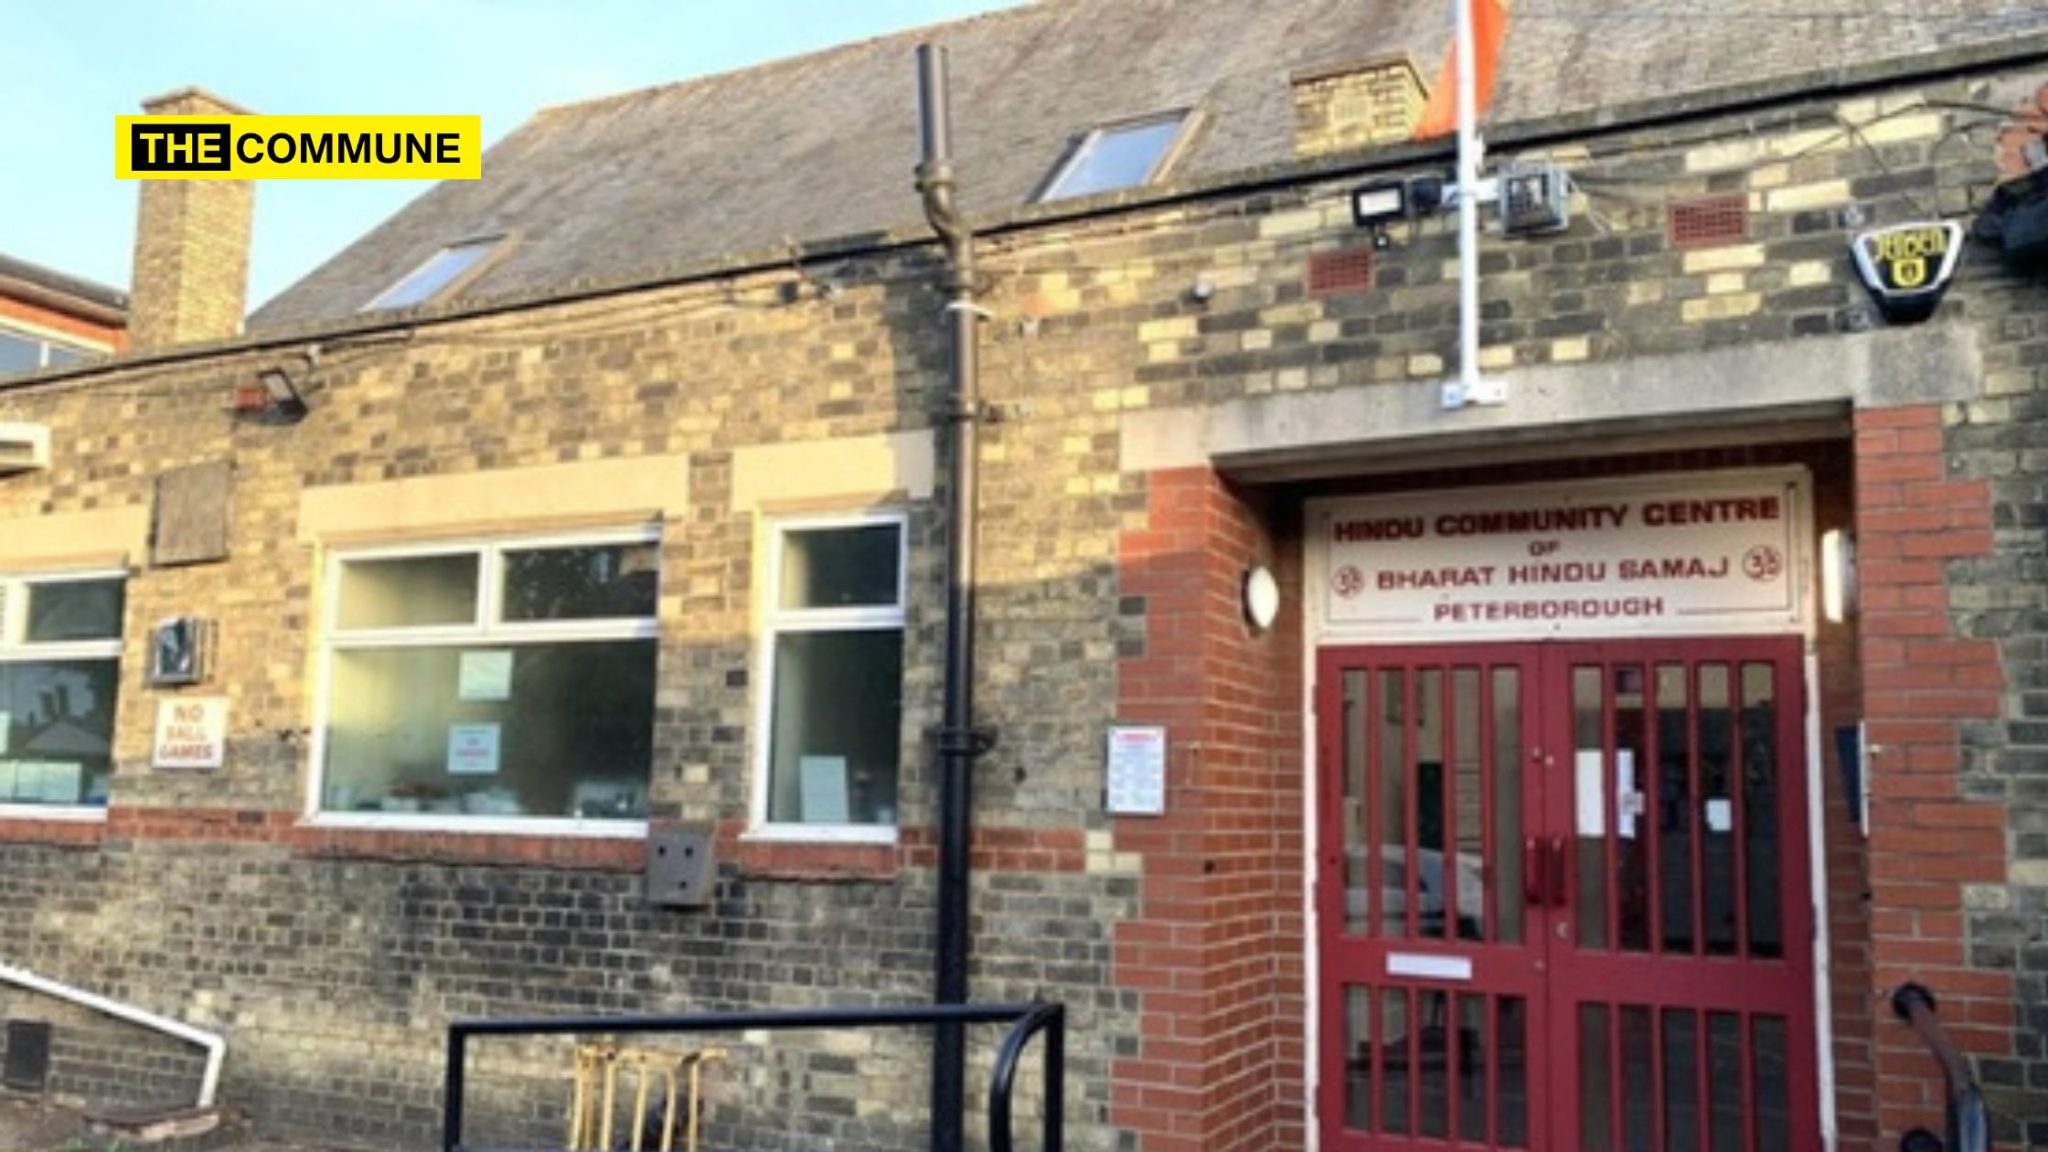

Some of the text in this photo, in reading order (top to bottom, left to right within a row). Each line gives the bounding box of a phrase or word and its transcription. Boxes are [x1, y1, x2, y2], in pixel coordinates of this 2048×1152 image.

[1334, 497, 1779, 541] HINDU COMMUNITY CENTRE
[1529, 540, 1560, 556] OF
[1377, 556, 1729, 589] BHARAT HINDU SAMAJ
[1434, 597, 1664, 621] PETERBOROUGH
[174, 704, 204, 723] NO
[159, 744, 213, 760] GAMES
